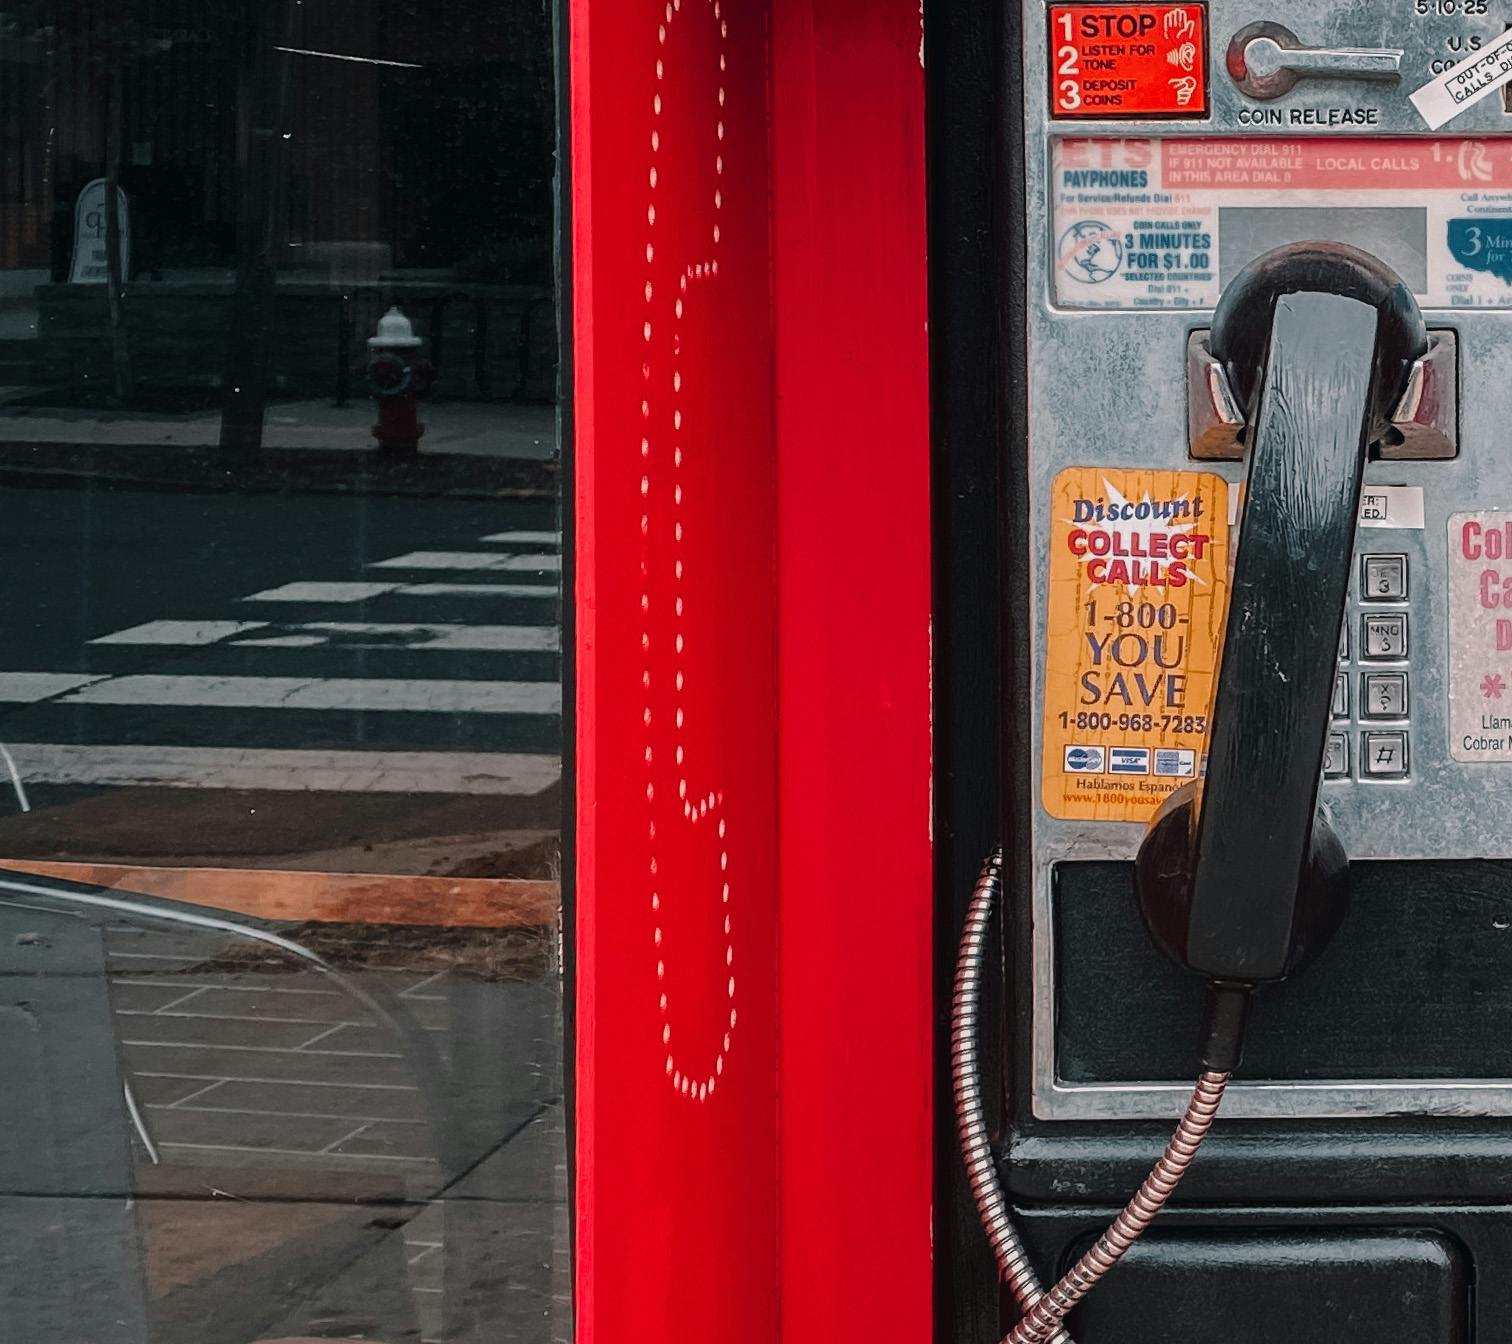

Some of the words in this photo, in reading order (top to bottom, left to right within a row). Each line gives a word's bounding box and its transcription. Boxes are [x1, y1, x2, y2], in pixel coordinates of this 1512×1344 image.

[1057, 13, 1073, 42] 1
[1080, 14, 1157, 39] STOP
[1057, 45, 1079, 76] 2
[1081, 44, 1126, 57] LISTEN
[1129, 44, 1156, 56] FOR
[1083, 58, 1117, 70] TONE
[1059, 80, 1082, 110] 3
[1082, 79, 1138, 91] DEPOSIT
[1455, 72, 1494, 102] CALLS
[1083, 94, 1122, 106] COINS
[1239, 109, 1283, 125] COIN
[1290, 109, 1379, 126] RELEASE
[1061, 138, 1152, 168] ETS
[1168, 144, 1249, 156] EMERGENCY
[1251, 144, 1279, 156] DIAL
[1282, 144, 1302, 156] 911
[1430, 142, 1453, 162] 1.
[1168, 157, 1180, 170] IF
[1184, 157, 1203, 169] 911
[1207, 157, 1232, 169] NOT
[1236, 157, 1303, 169] AVAILABLE
[1316, 158, 1366, 171] LOCAL
[1371, 158, 1420, 171] CALLS
[1063, 170, 1148, 188] PAYPHONES
[1168, 171, 1182, 183] IN
[1185, 171, 1211, 183] THIS
[1215, 171, 1249, 183] AREA
[1252, 171, 1280, 183] DIAL
[1060, 194, 1075, 203] For
[1153, 193, 1173, 203] Dial
[1460, 193, 1478, 202] Call
[1133, 221, 1152, 230] COIN
[1154, 221, 1180, 230] CALLS
[1182, 221, 1202, 230] ONLY
[1125, 234, 1135, 250] 3
[1139, 233, 1211, 250] MINUTES
[1461, 227, 1481, 256] 3
[1128, 254, 1159, 269] FOR
[1163, 253, 1210, 271] $1.00
[1486, 249, 1505, 265] for
[1072, 494, 1206, 524] Discount
[1067, 528, 1210, 560] COLLECT
[1087, 558, 1188, 587] CALLS
[1083, 599, 1189, 630] 1-800-
[1085, 632, 1184, 669] YOU
[1080, 670, 1187, 708] SAVE
[1058, 711, 1207, 734] 1-800-968-7283
[1463, 735, 1505, 751] Cobrar
[1076, 777, 1135, 791] Hablamos
